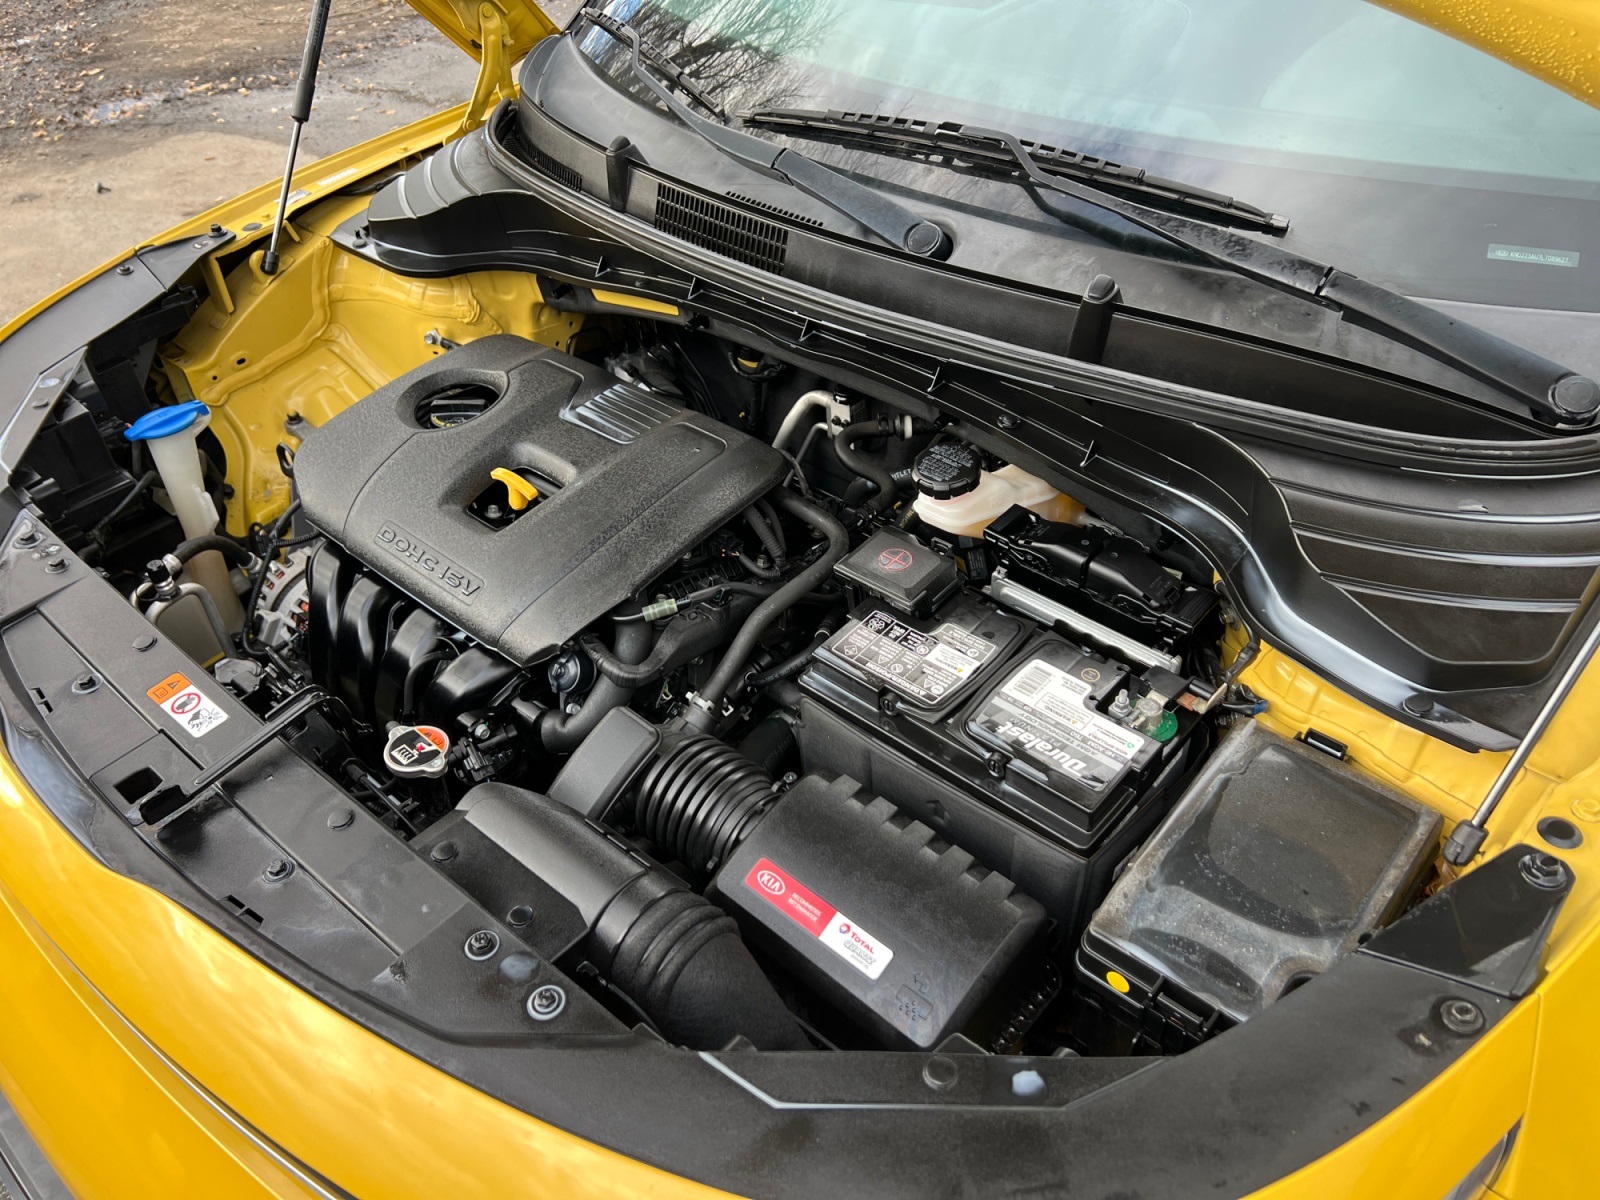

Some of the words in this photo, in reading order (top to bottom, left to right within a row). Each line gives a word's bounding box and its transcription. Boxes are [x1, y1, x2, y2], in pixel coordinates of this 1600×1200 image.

[891, 468, 911, 480] UTLET
[377, 528, 440, 572] DOHC
[438, 565, 481, 596] 16V
[866, 662, 919, 693] DANGER/POISON
[1009, 717, 1062, 746] PLATINUM
[1017, 713, 1074, 744] TECHNOLOGY
[1070, 730, 1083, 739] 760
[995, 721, 1087, 777] Duralast
[1075, 741, 1097, 755] AGM
[1087, 740, 1116, 757] H6-AGM
[760, 872, 782, 893] KIA
[844, 940, 876, 965] QUARTZ
[851, 932, 875, 954] TOTAL
